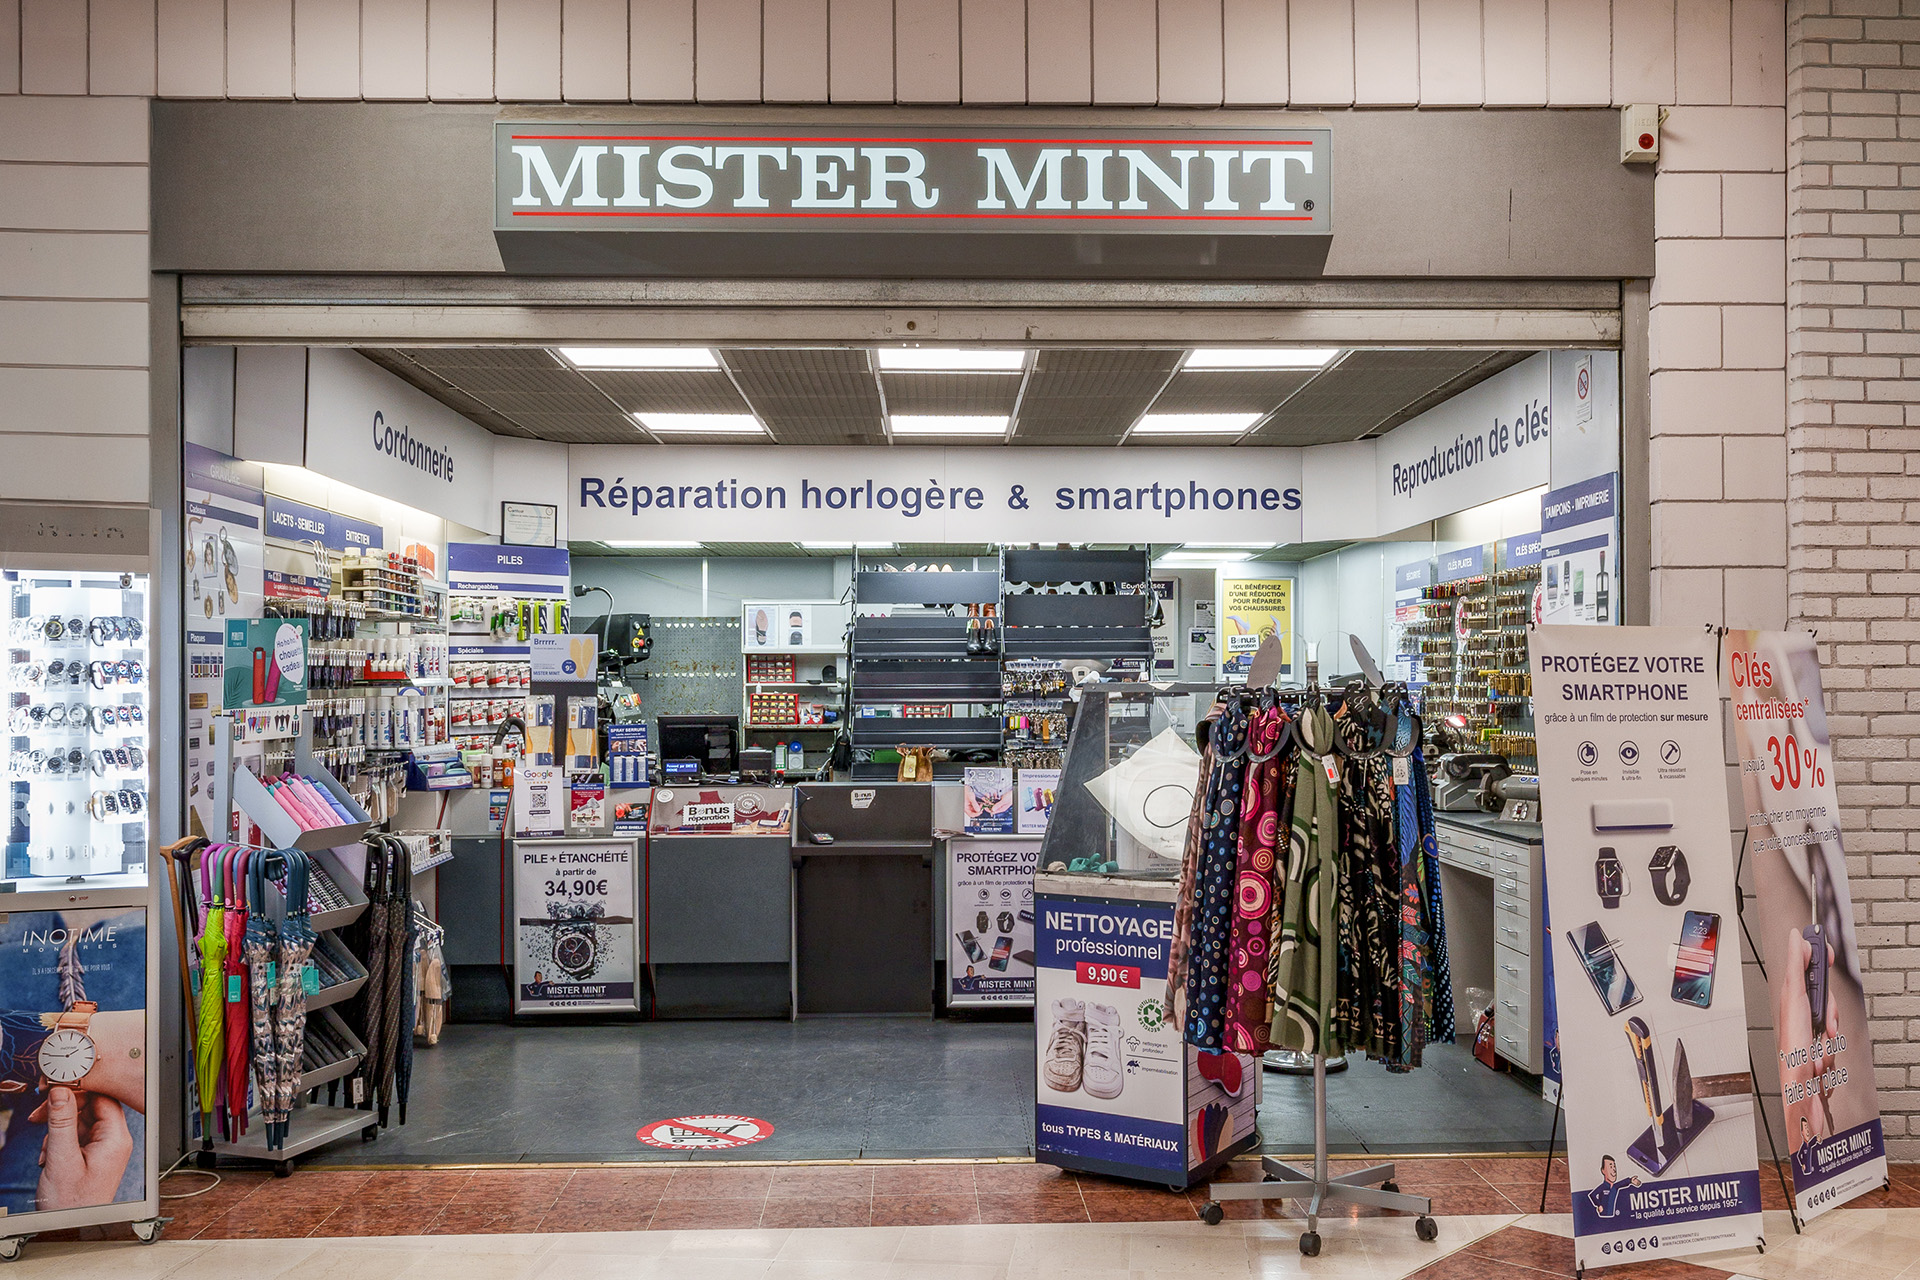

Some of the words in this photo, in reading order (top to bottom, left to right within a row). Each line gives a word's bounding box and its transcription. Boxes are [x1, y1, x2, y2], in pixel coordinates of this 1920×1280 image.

[511, 144, 939, 210] MISTER
[976, 146, 1313, 212] MINIT
[372, 409, 454, 483] Cordonnerie
[1392, 433, 1484, 498] Reproduction
[1489, 418, 1509, 458] de
[1515, 399, 1549, 448] clés
[580, 476, 787, 516] Réparation
[801, 478, 985, 518] horlogère
[1007, 484, 1030, 511] &
[1055, 480, 1302, 518] smartphones
[1544, 500, 1571, 520] TAMPONS
[1574, 489, 1609, 512] IMPRIMERIE
[272, 510, 294, 528] LACETS
[297, 517, 326, 536] SEMELLES
[345, 529, 370, 546] ENTRETIEN
[1515, 542, 1528, 557] CLÉS
[497, 555, 523, 565] PILES
[1458, 557, 1473, 569] PLATES
[457, 582, 499, 591] Rechargeables
[190, 632, 206, 643] Plaques
[457, 647, 484, 655] Spéciales
[1541, 653, 1640, 673] PROTÉGEZ
[1644, 656, 1705, 673] VOTRE
[1731, 651, 1773, 688] Clés
[1562, 683, 1688, 701] SMARTPHONE
[1544, 712, 1567, 724] grâce
[1570, 712, 1576, 722] à
[1578, 714, 1588, 722] un
[1590, 712, 1604, 722] film
[1606, 712, 1617, 722] de
[1619, 712, 1658, 724] protection
[1660, 714, 1675, 722] sur
[1676, 713, 1709, 722] mesure
[1743, 757, 1766, 777] jusqu'à
[1767, 734, 1802, 792] 30
[1804, 748, 1825, 789] %
[524, 769, 553, 780] Google
[688, 814, 730, 823] réparation
[1749, 809, 1768, 827] moins
[1769, 807, 1783, 824] cher
[1785, 810, 1795, 822] en
[1795, 805, 1827, 823] moyenne
[1753, 838, 1765, 856] que
[1766, 833, 1782, 851] votre
[1783, 827, 1839, 848] concessionnaire
[523, 854, 548, 864] PILE
[559, 851, 628, 863] ÉTANCHÉITÉ
[956, 850, 1017, 863] PROTÉGEZ
[555, 868, 560, 876] à
[562, 868, 585, 877] partir
[586, 868, 597, 876] de
[968, 865, 1036, 876] SMARTPHON
[544, 880, 608, 899] 34,90€
[1045, 910, 1173, 940] NETTOYAGE
[22, 926, 118, 947] INOTIME
[22, 944, 117, 953] MONRES
[1056, 937, 1161, 960] professionnel
[1087, 966, 1117, 983] 9,90
[546, 986, 580, 995] MISTER
[582, 985, 607, 994] MINIT
[1809, 1034, 1824, 1061] clé
[1826, 1032, 1848, 1056] auto
[1142, 1065, 1178, 1075] imperméabilisation
[1784, 1082, 1805, 1106] faite
[1805, 1077, 1821, 1098] sur
[1822, 1066, 1849, 1096] place
[1042, 1122, 1064, 1134] tous
[1066, 1125, 1101, 1140] TYPES
[1103, 1131, 1112, 1142] &
[1114, 1132, 1179, 1152] MATÉRIAUX
[1816, 1144, 1849, 1166] MISTER
[1849, 1129, 1872, 1152] MINIT
[1629, 1188, 1693, 1211] MISTER
[1696, 1180, 1741, 1202] MINIT
[1635, 1211, 1642, 1219] la
[1643, 1208, 1665, 1220] qualité
[1666, 1206, 1675, 1215] du
[1676, 1204, 1699, 1214] service
[1699, 1201, 1721, 1212] depuis
